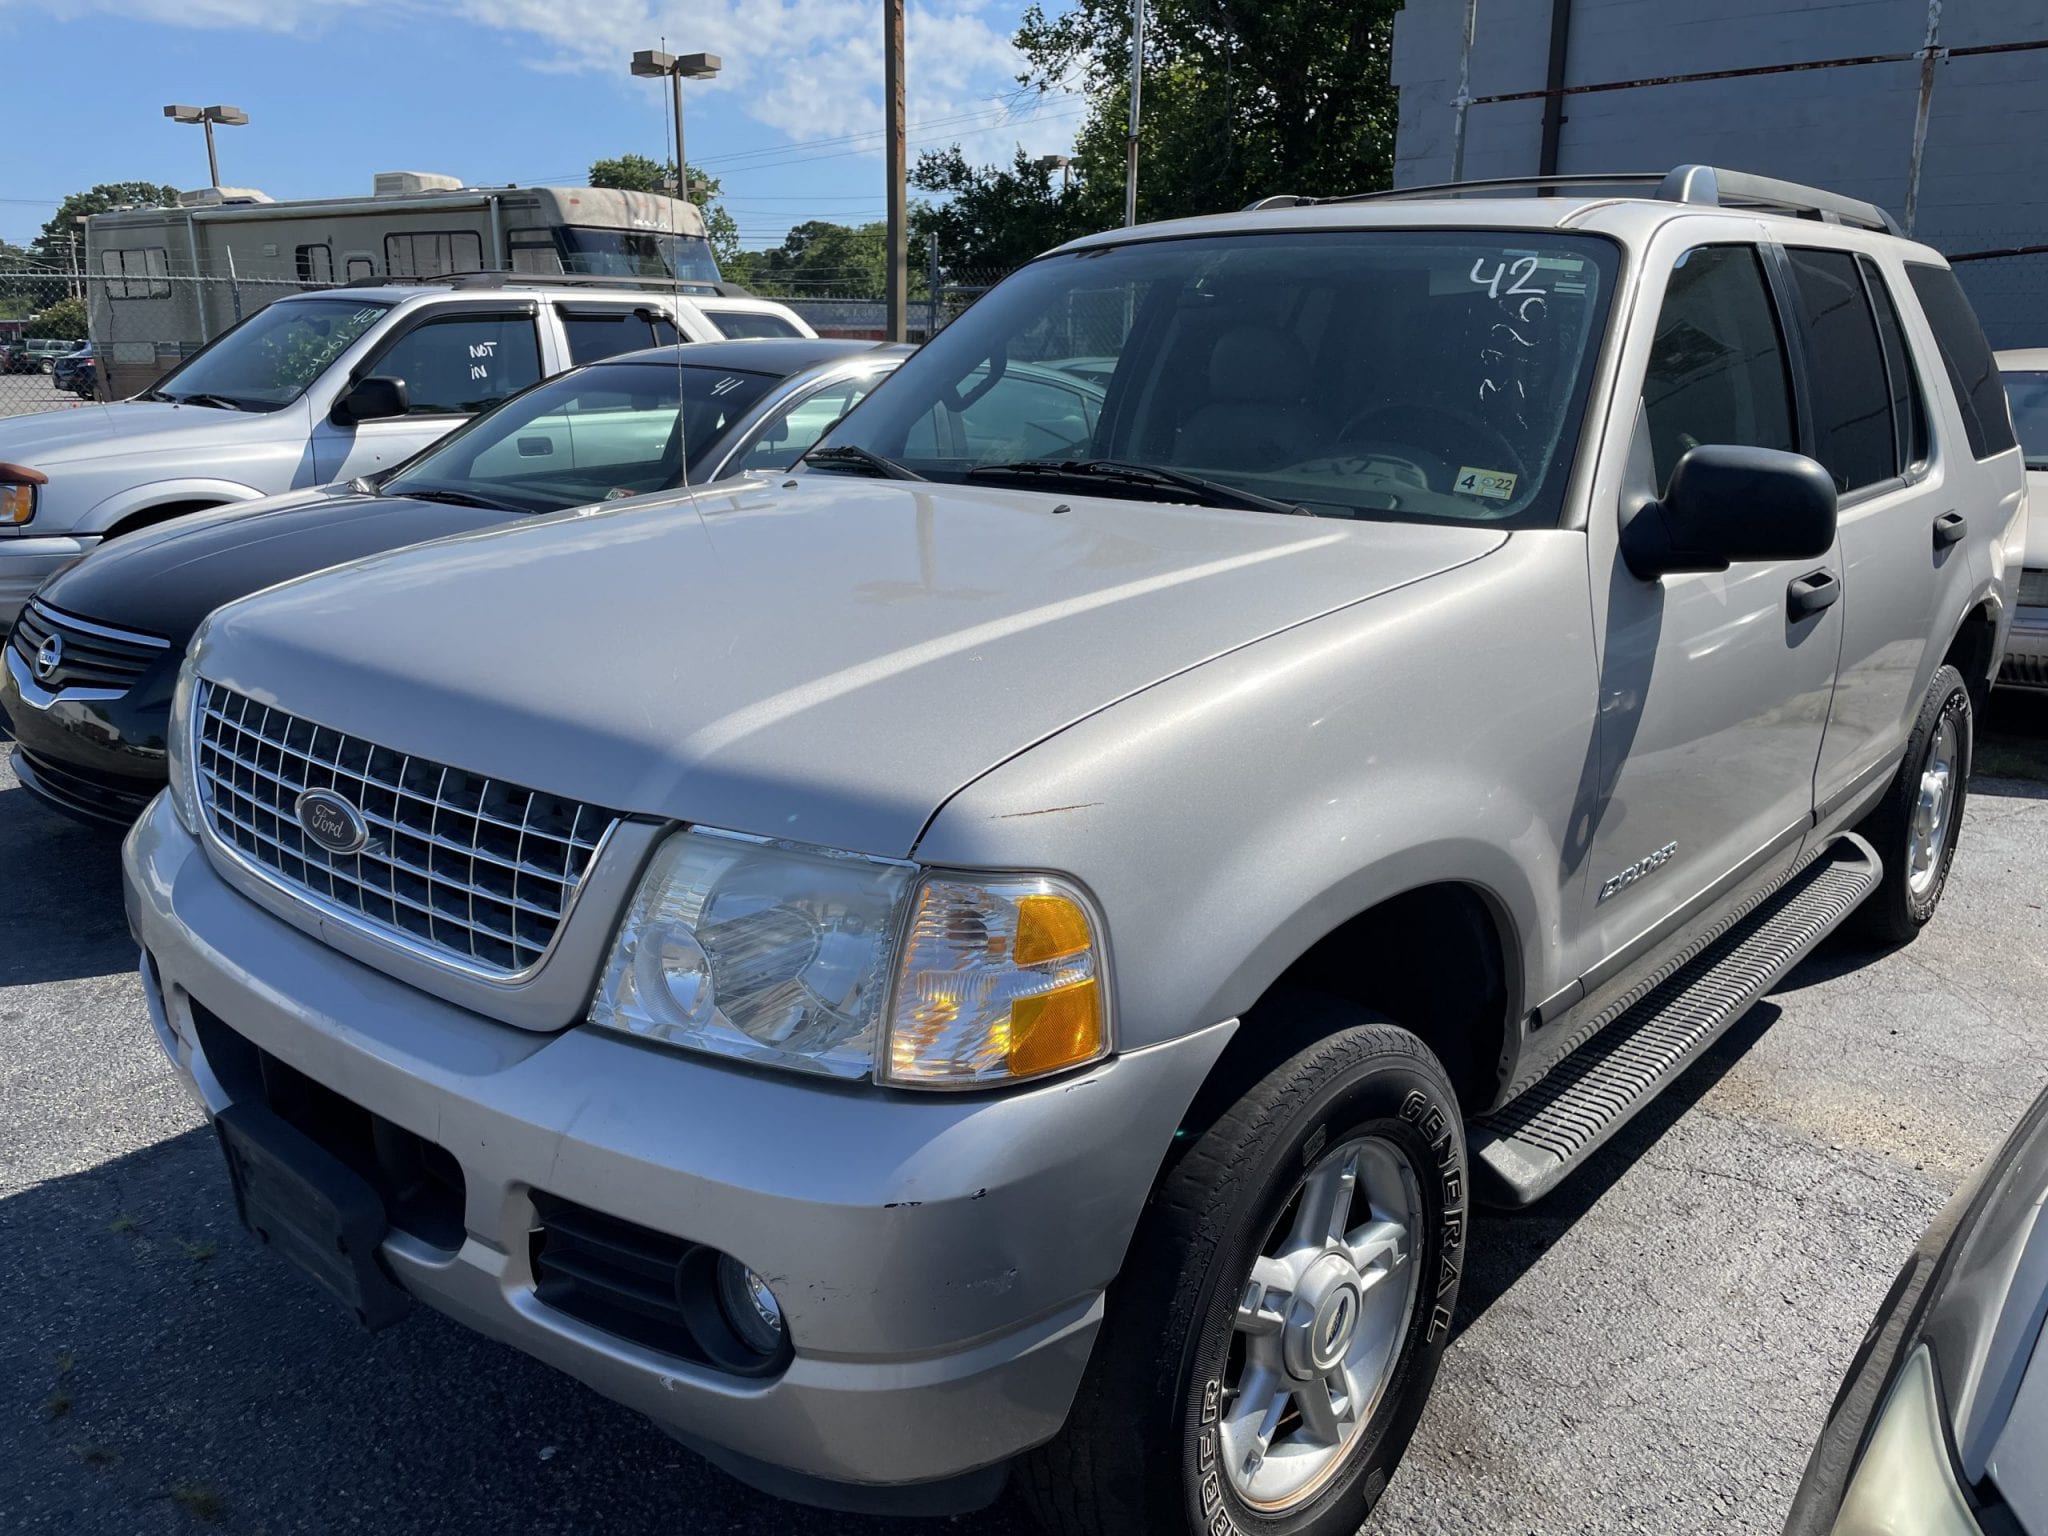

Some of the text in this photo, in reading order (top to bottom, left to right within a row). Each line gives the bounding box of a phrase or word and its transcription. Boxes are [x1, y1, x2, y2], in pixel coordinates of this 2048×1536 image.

[1470, 257, 1547, 298] 42
[469, 341, 498, 358] NOT
[710, 376, 745, 396] 41
[1461, 474, 1513, 491] 4 22
[312, 804, 344, 839] Ford
[1399, 1089, 1464, 1344] GENERAL
[1199, 1378, 1242, 1536] BBER
